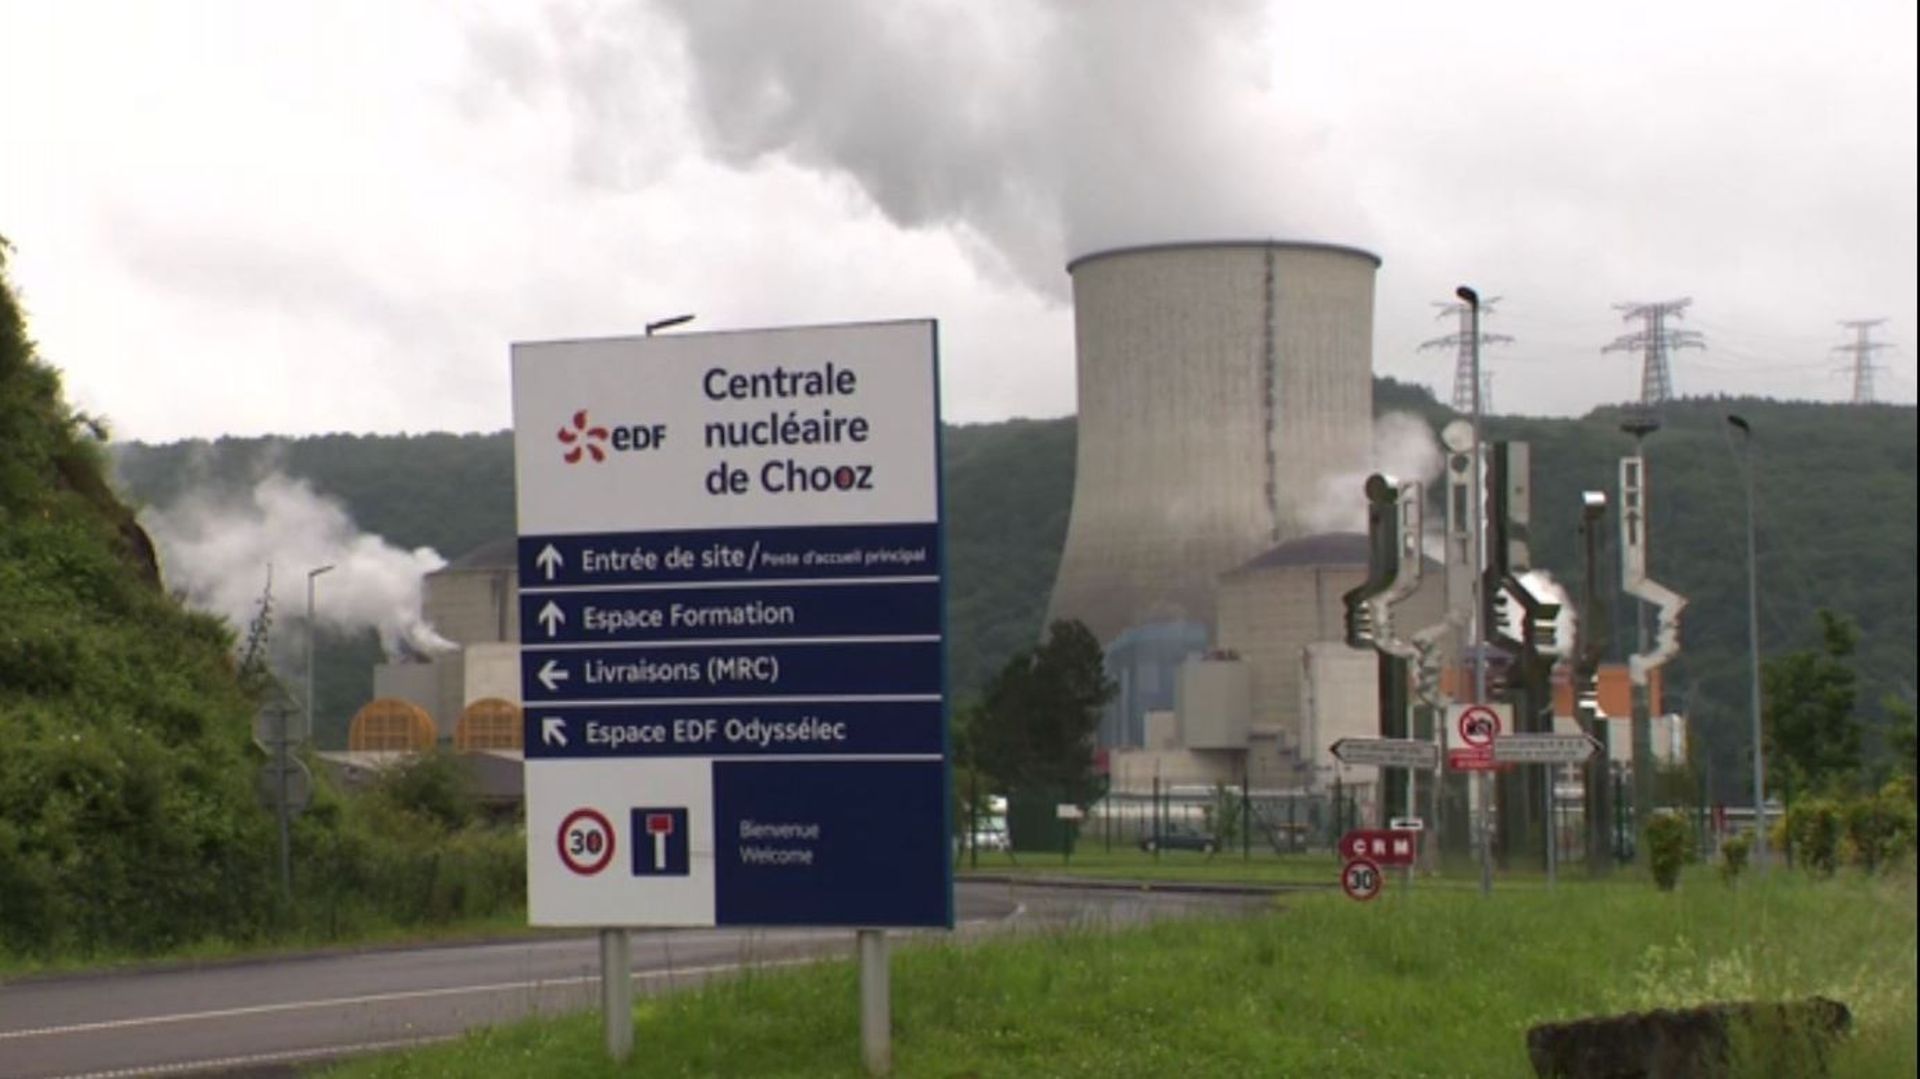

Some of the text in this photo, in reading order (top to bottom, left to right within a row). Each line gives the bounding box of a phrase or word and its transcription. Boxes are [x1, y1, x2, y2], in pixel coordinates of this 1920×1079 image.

[704, 363, 856, 400] Centrale
[705, 411, 869, 448] nucléaire
[706, 460, 873, 495] de Chooz
[582, 547, 658, 571] Entrée
[664, 546, 694, 570] de
[803, 549, 862, 565] d'accueil
[865, 548, 925, 567] principal
[583, 601, 794, 633] Espace Formation
[585, 656, 779, 684] Livraisons (MRC)
[586, 716, 847, 748] Espace EDF Odyssélec
[570, 830, 603, 856] 30
[740, 820, 819, 838] Bienvenue
[740, 846, 813, 865] Welcome
[1352, 870, 1373, 889] 30
